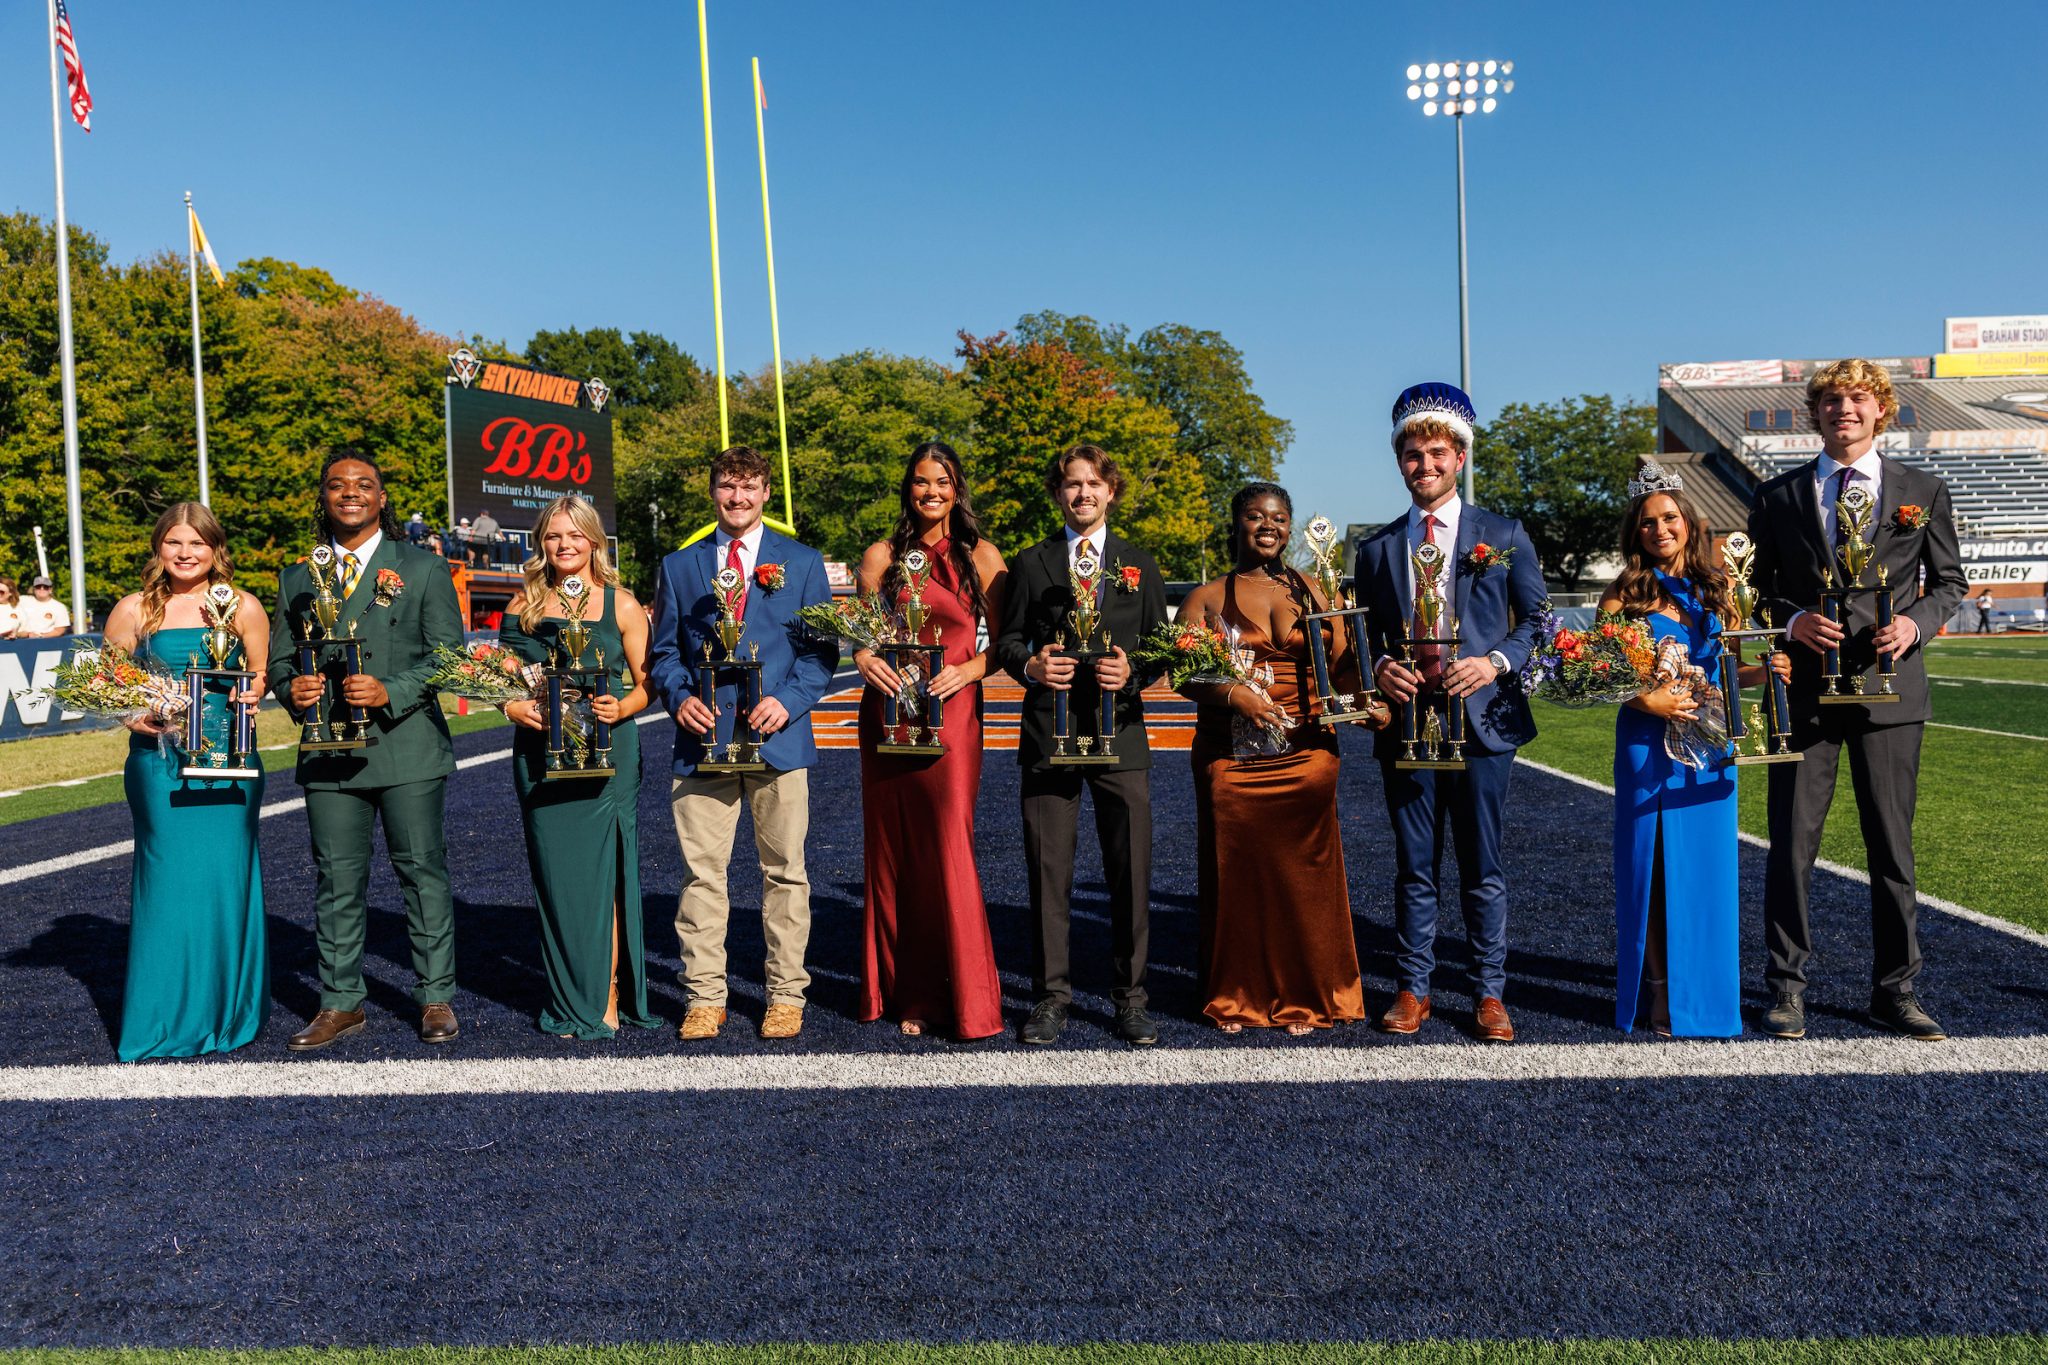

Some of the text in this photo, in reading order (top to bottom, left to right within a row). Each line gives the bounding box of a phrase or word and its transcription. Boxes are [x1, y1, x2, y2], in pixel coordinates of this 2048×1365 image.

[1982, 329, 2020, 343] GRAHAM
[2023, 351, 2048, 367] Jon
[480, 363, 580, 406] SKYHAWKS
[481, 416, 592, 484] BB's
[482, 480, 523, 497] Furniture
[524, 485, 532, 497] &
[567, 490, 595, 505] Gllery
[1959, 539, 2048, 560] eyauto.c
[1964, 564, 2032, 581] eakley
[1076, 736, 1093, 746] 2025
[210, 752, 228, 761] 2025
